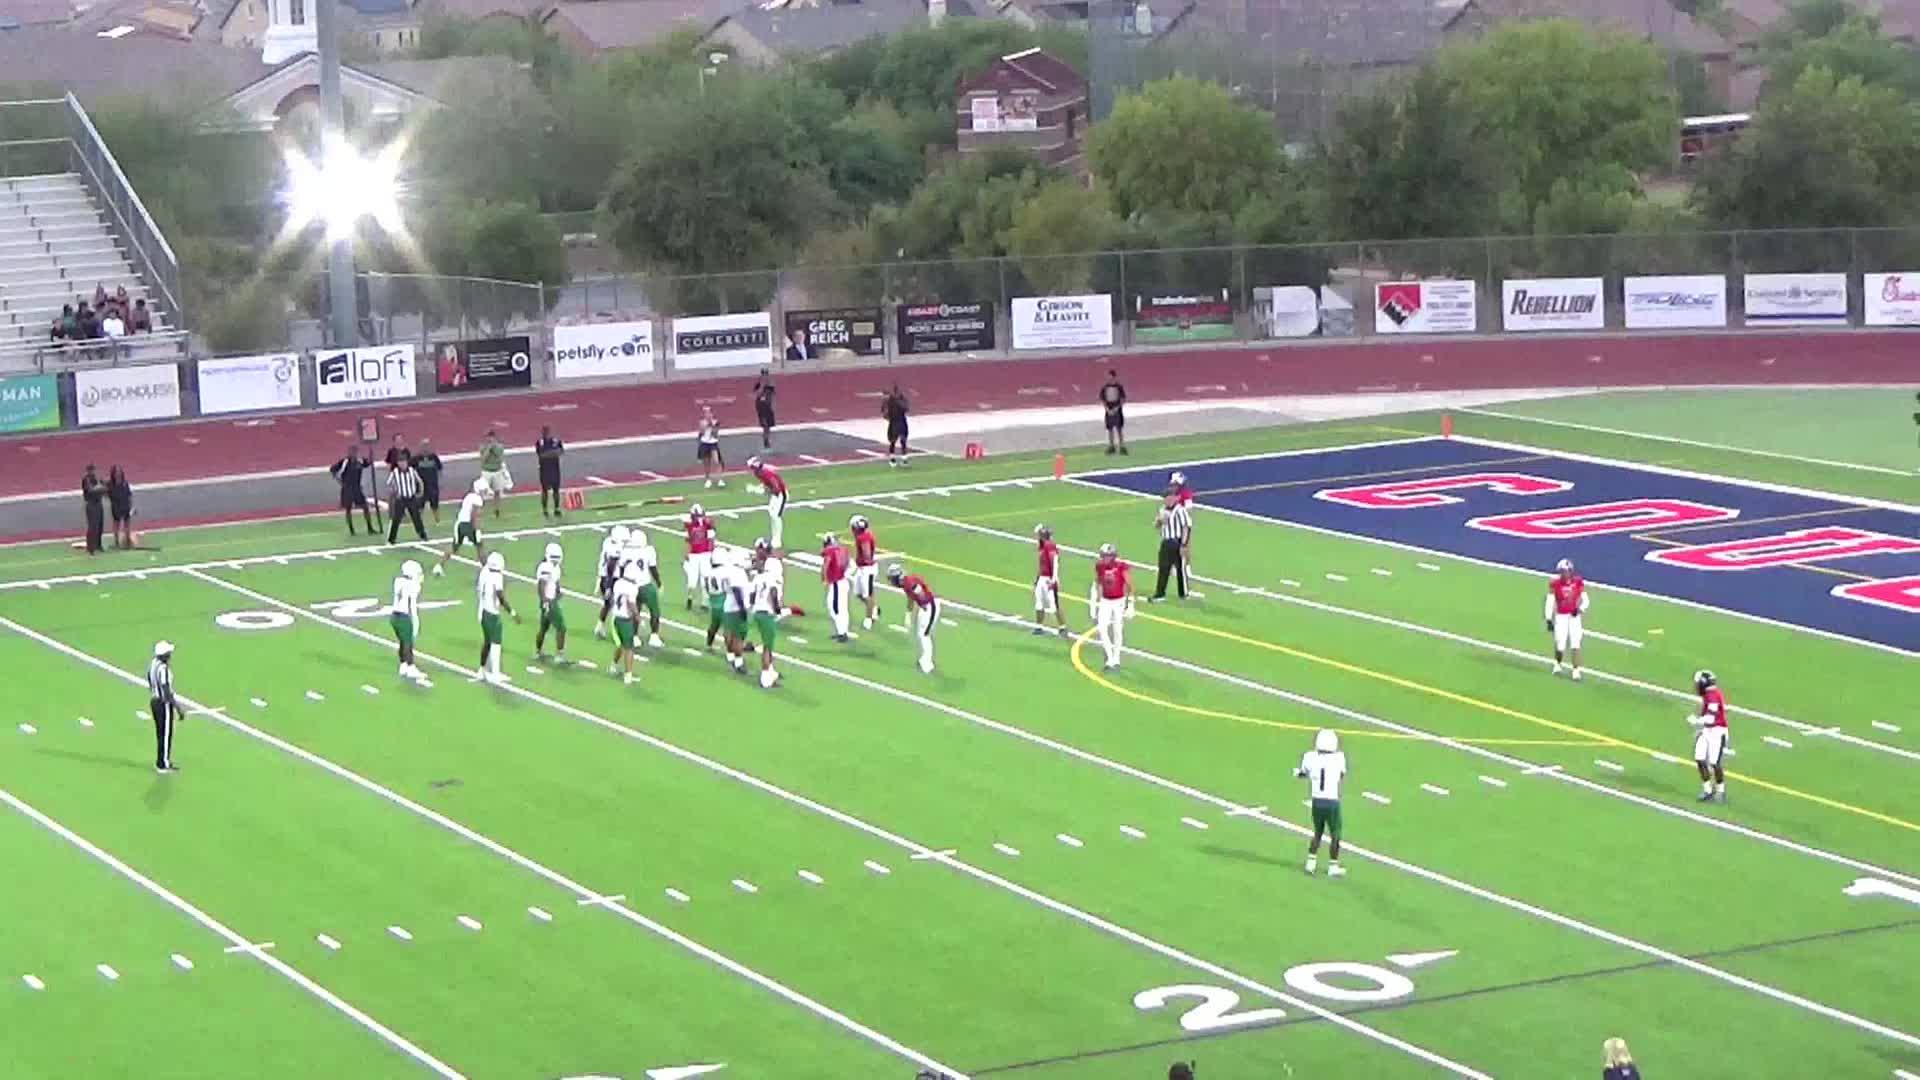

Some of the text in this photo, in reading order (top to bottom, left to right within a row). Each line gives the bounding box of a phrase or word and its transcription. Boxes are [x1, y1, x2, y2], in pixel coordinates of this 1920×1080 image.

[1510, 290, 1596, 315] REBELLION
[809, 320, 845, 332] GREG
[810, 332, 849, 344] REICH
[320, 350, 407, 385] aloft
[0, 386, 41, 401] MAN
[1133, 961, 1415, 1032] 20
